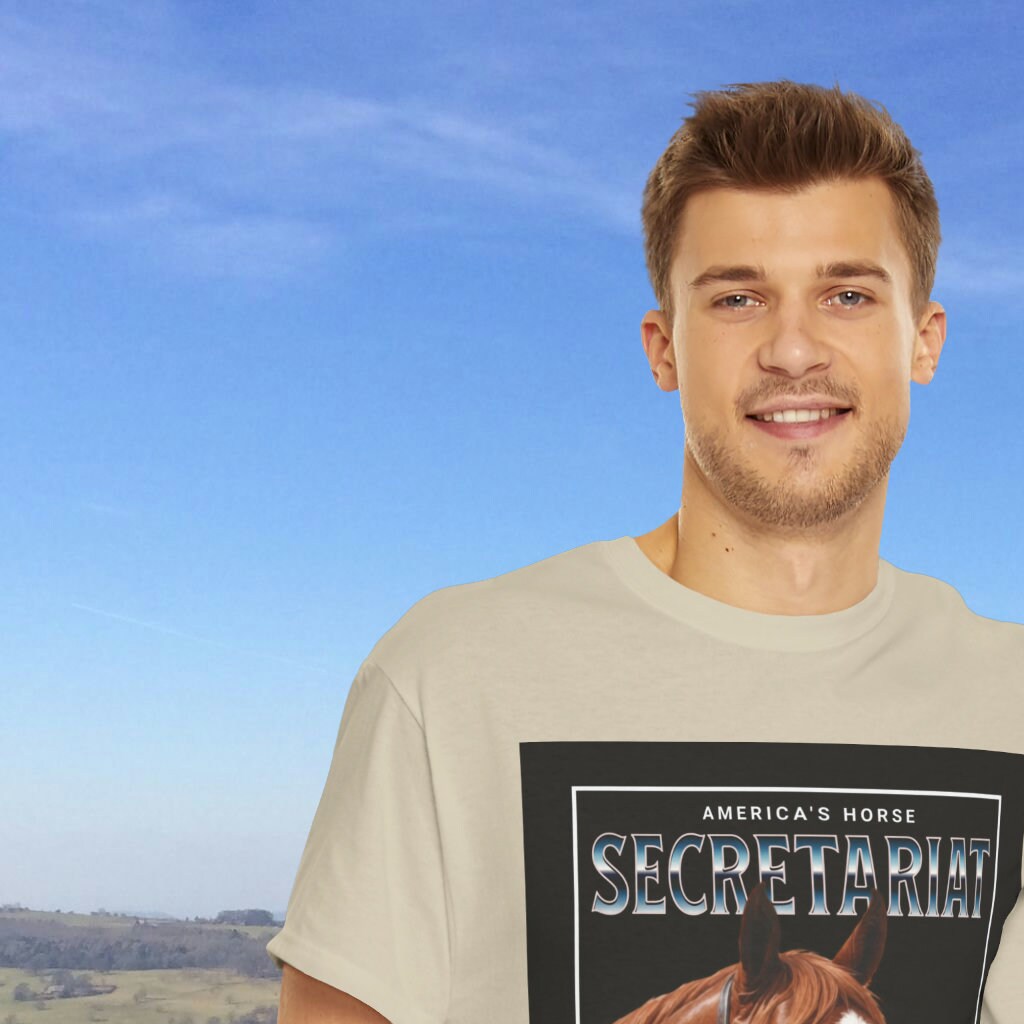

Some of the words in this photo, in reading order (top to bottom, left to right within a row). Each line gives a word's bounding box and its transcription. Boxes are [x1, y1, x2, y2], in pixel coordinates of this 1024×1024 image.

[703, 806, 830, 821] AMERICA'S
[844, 808, 915, 823] HORSE
[591, 832, 991, 919] SECRETARIAT
